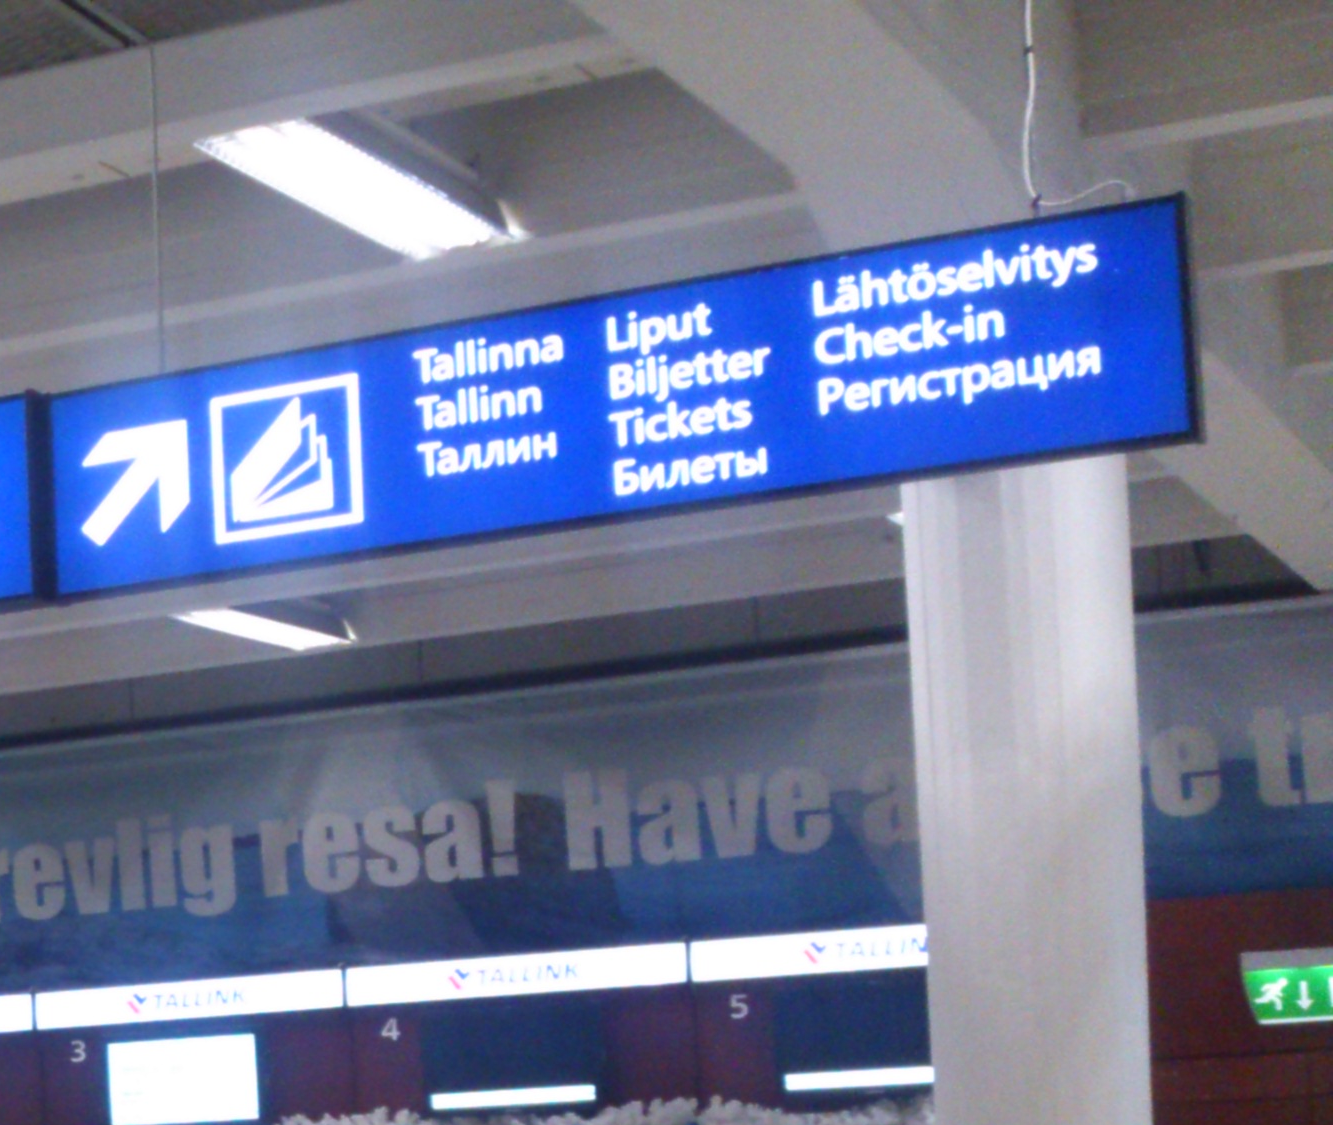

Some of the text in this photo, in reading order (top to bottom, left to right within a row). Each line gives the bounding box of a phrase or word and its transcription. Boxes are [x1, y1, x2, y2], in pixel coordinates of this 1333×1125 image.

[813, 242, 1098, 318] Lähtöselvitys
[606, 302, 713, 356] Liput
[814, 303, 1006, 365] Check-in
[413, 333, 564, 384] Tallinna
[608, 346, 771, 403] Biljetter
[817, 345, 1102, 416] Регистрация
[414, 384, 543, 431] Tallinn
[609, 396, 753, 448] Tickets
[417, 431, 558, 478] Таллин
[613, 446, 768, 497] Билеты
[259, 780, 520, 898] resa!
[564, 767, 833, 870] Have
[835, 934, 928, 958] TALLIN
[477, 963, 579, 984] TALLINK
[153, 989, 245, 1010] TALLINK
[729, 994, 749, 1020] 5
[70, 1040, 87, 1063] 3
[380, 1017, 401, 1041] 4
